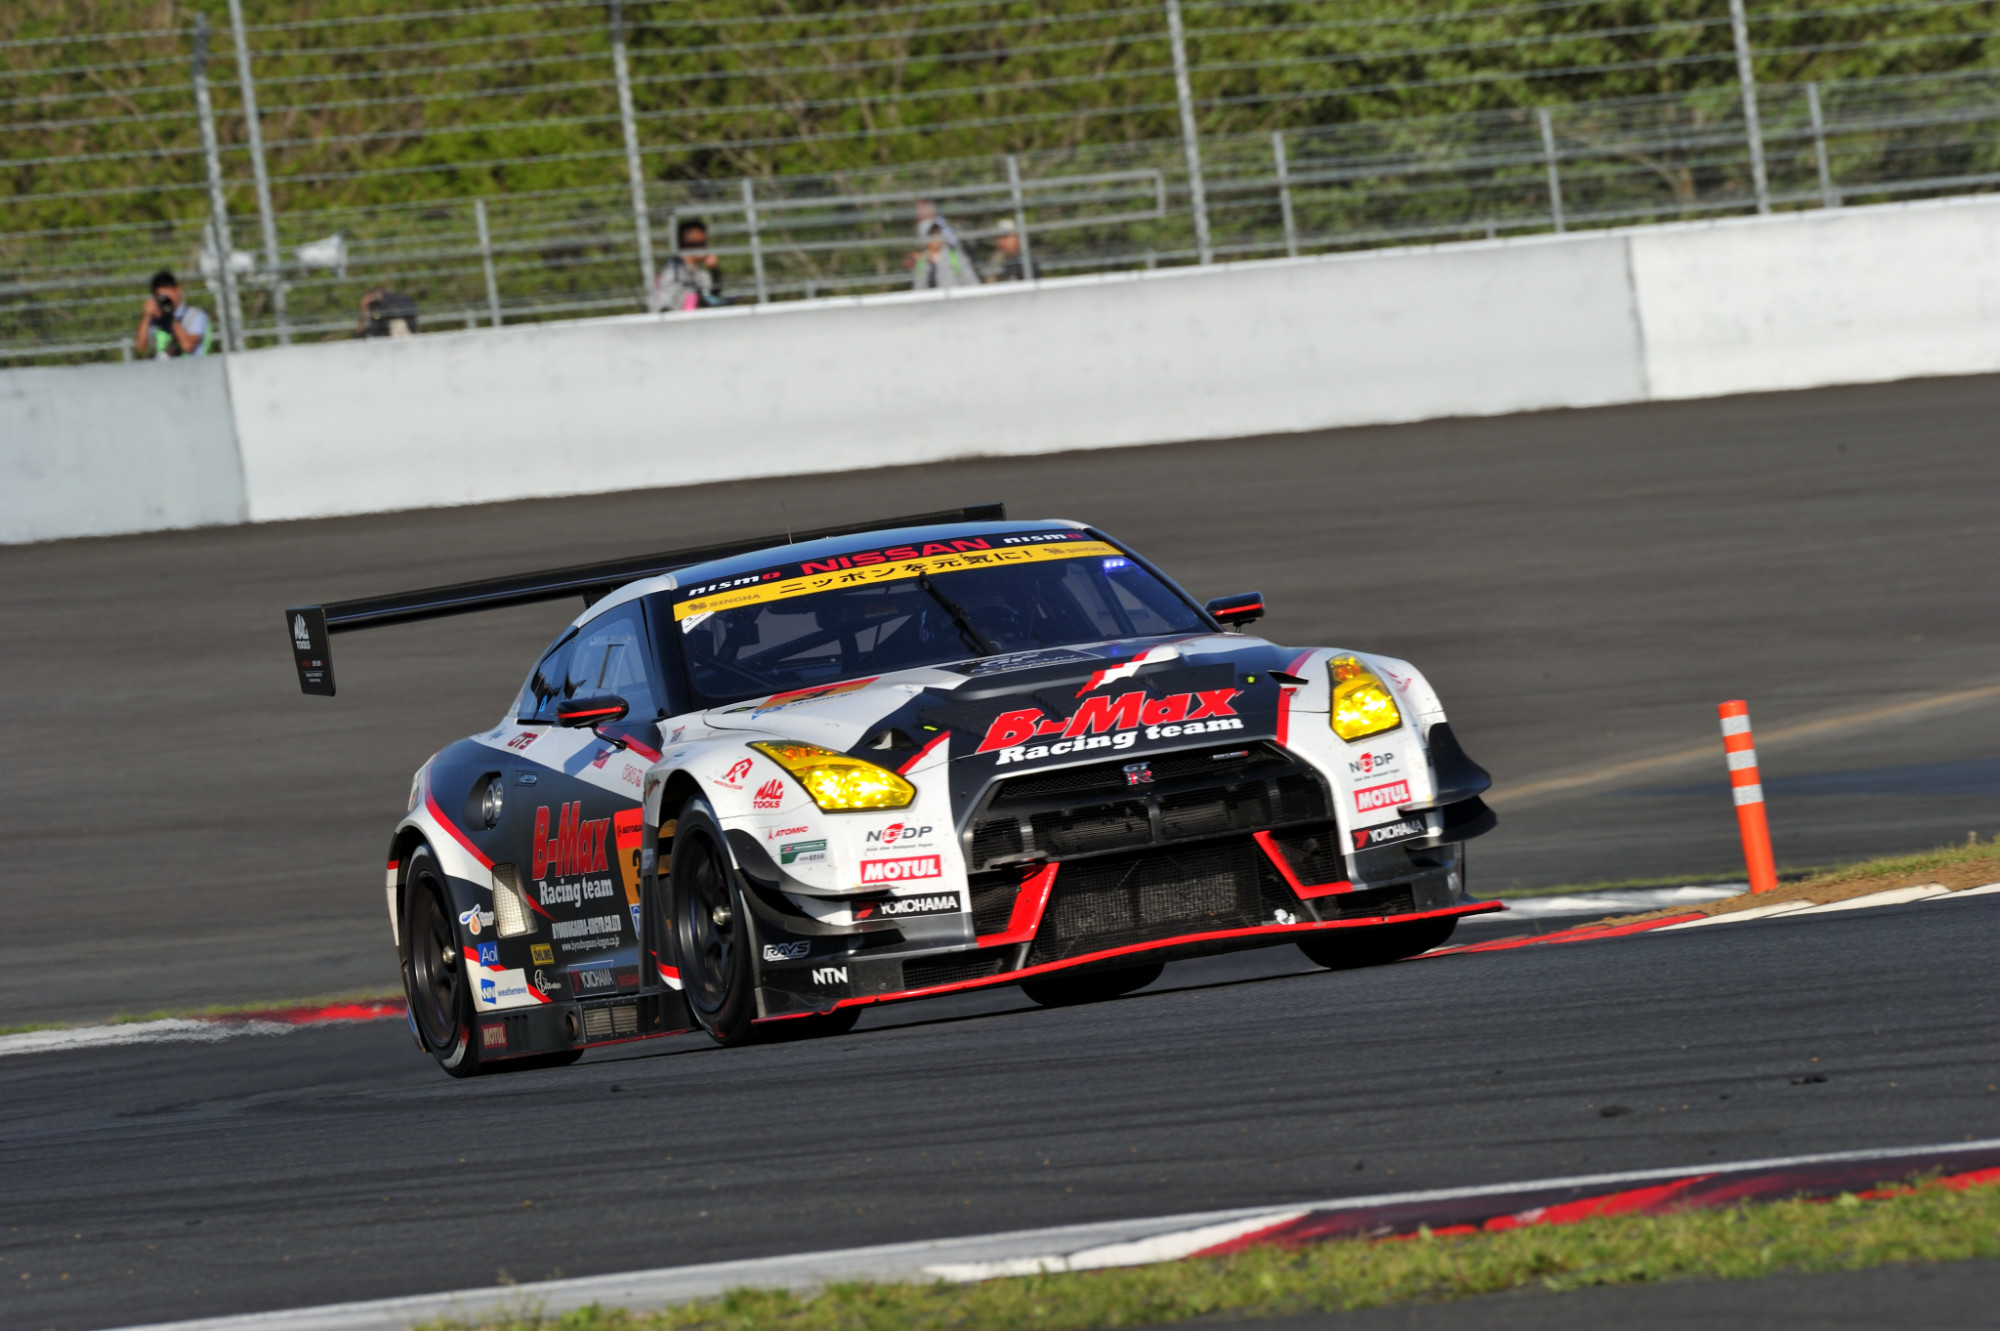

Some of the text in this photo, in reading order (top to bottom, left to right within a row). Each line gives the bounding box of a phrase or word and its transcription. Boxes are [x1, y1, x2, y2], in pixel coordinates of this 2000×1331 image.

[1004, 532, 1083, 544] nismo
[800, 538, 991, 576] NISSAN
[688, 571, 781, 597] nismo
[975, 688, 1244, 753] B-Max
[996, 718, 1244, 766] Racing team
[753, 800, 781, 809] TOOLS
[1358, 786, 1409, 812] MOTUL
[775, 826, 809, 837] ATOMIC
[1369, 818, 1424, 842] YOKOHAMA
[532, 801, 610, 882] B-Max
[863, 862, 939, 882] MOTUL
[539, 876, 614, 908] Racing team
[880, 895, 959, 915] YOKOHAMA
[763, 941, 810, 961] RAYS
[579, 967, 614, 989] YOKOHAMA
[812, 966, 848, 985] NTN
[483, 1026, 506, 1047] MOTUL
